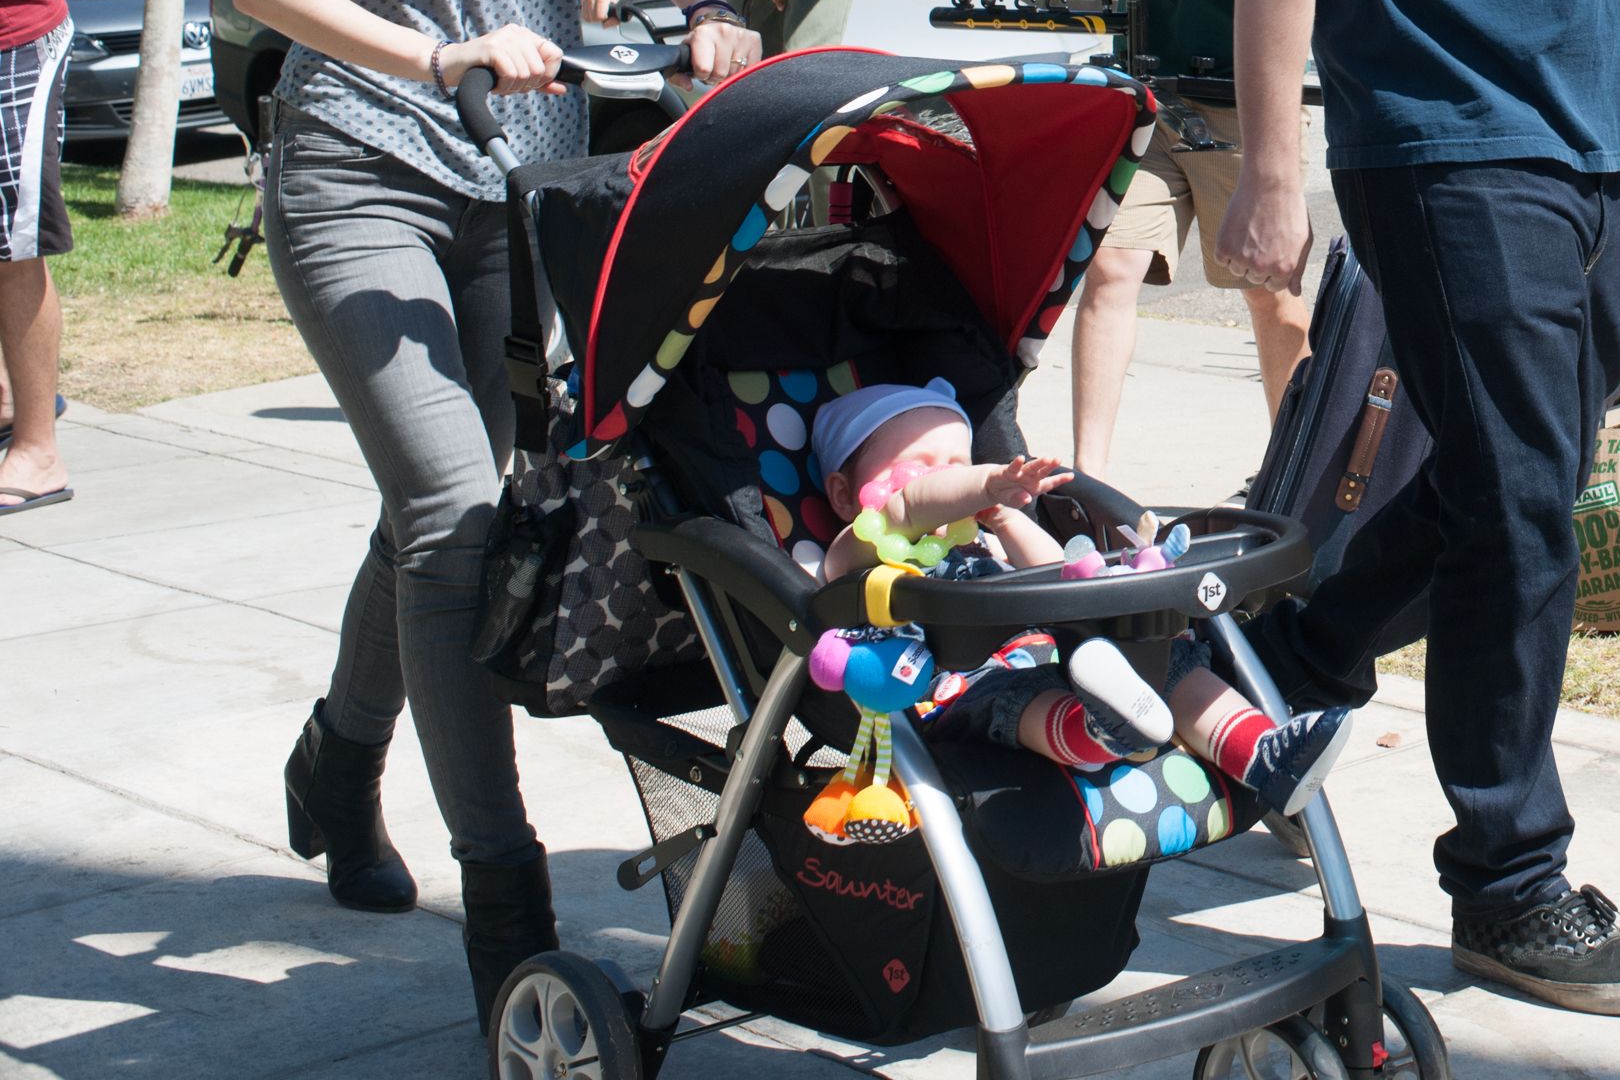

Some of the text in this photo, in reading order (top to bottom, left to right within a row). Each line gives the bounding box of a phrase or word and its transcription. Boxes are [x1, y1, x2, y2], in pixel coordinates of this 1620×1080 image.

[182, 78, 212, 96] 6VMS
[1578, 486, 1614, 503] AUL
[1202, 582, 1221, 603] 1st
[796, 857, 924, 910] Saunter
[887, 966, 906, 981] 1st
